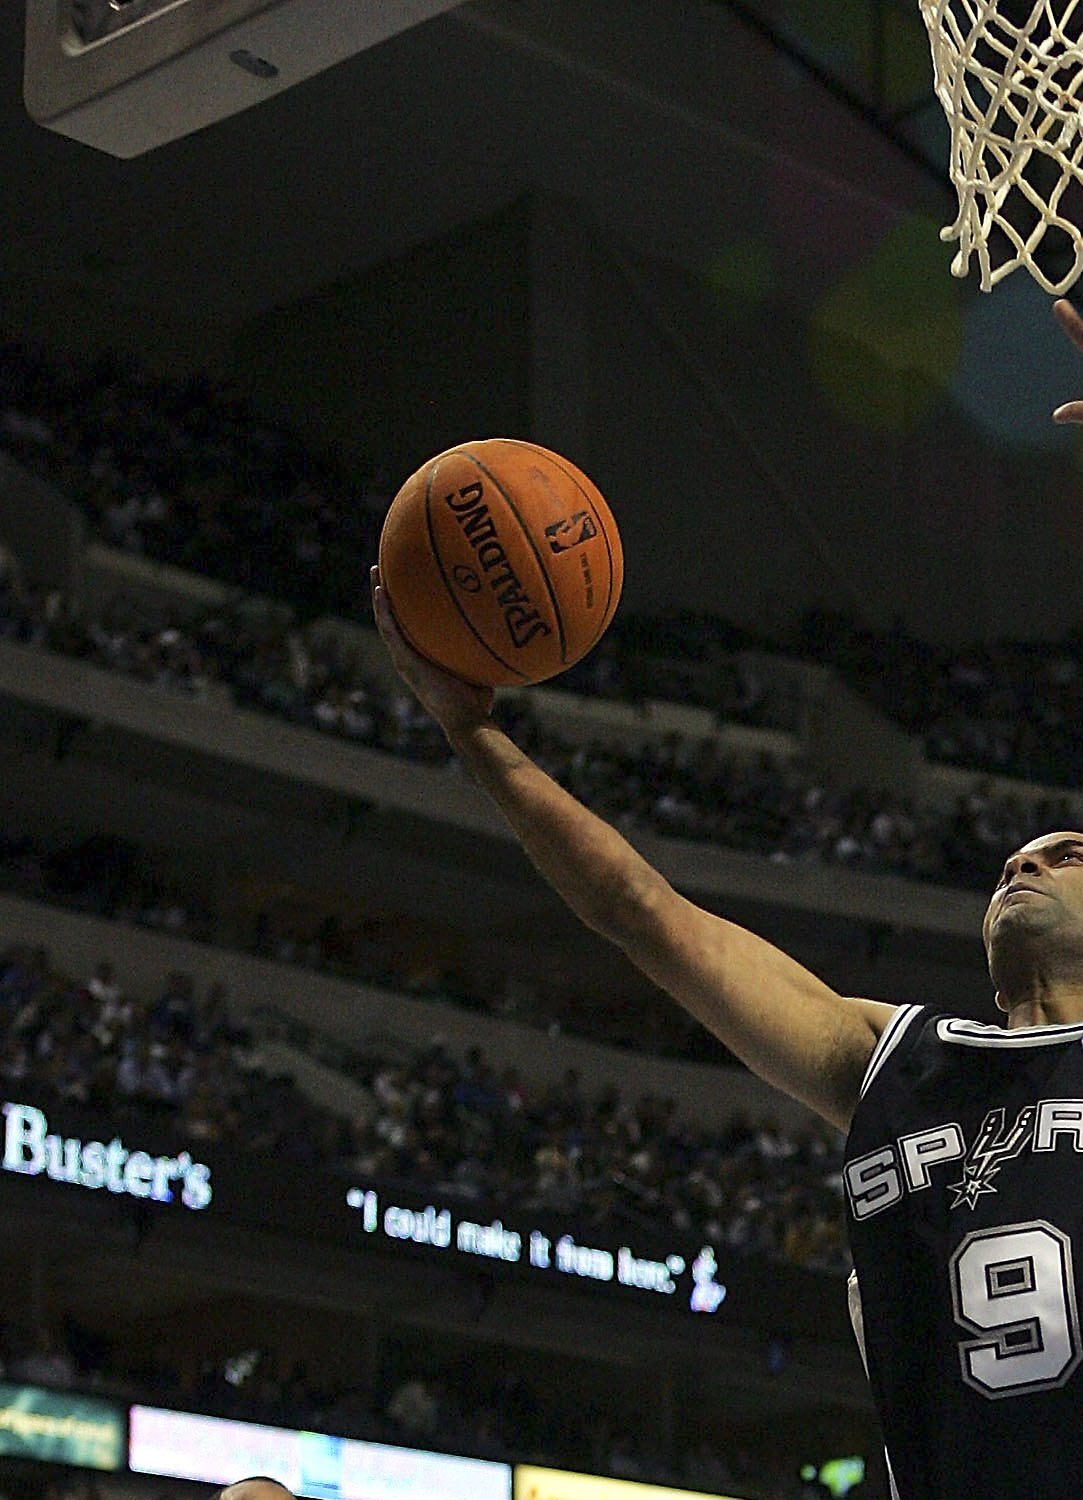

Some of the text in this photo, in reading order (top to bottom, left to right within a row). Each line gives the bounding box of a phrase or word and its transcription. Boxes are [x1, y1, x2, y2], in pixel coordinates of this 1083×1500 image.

[446, 481, 550, 648] SPALDING
[1, 1103, 212, 1210] Buster's
[384, 1204, 451, 1248] could
[947, 1218, 1083, 1400] 9
